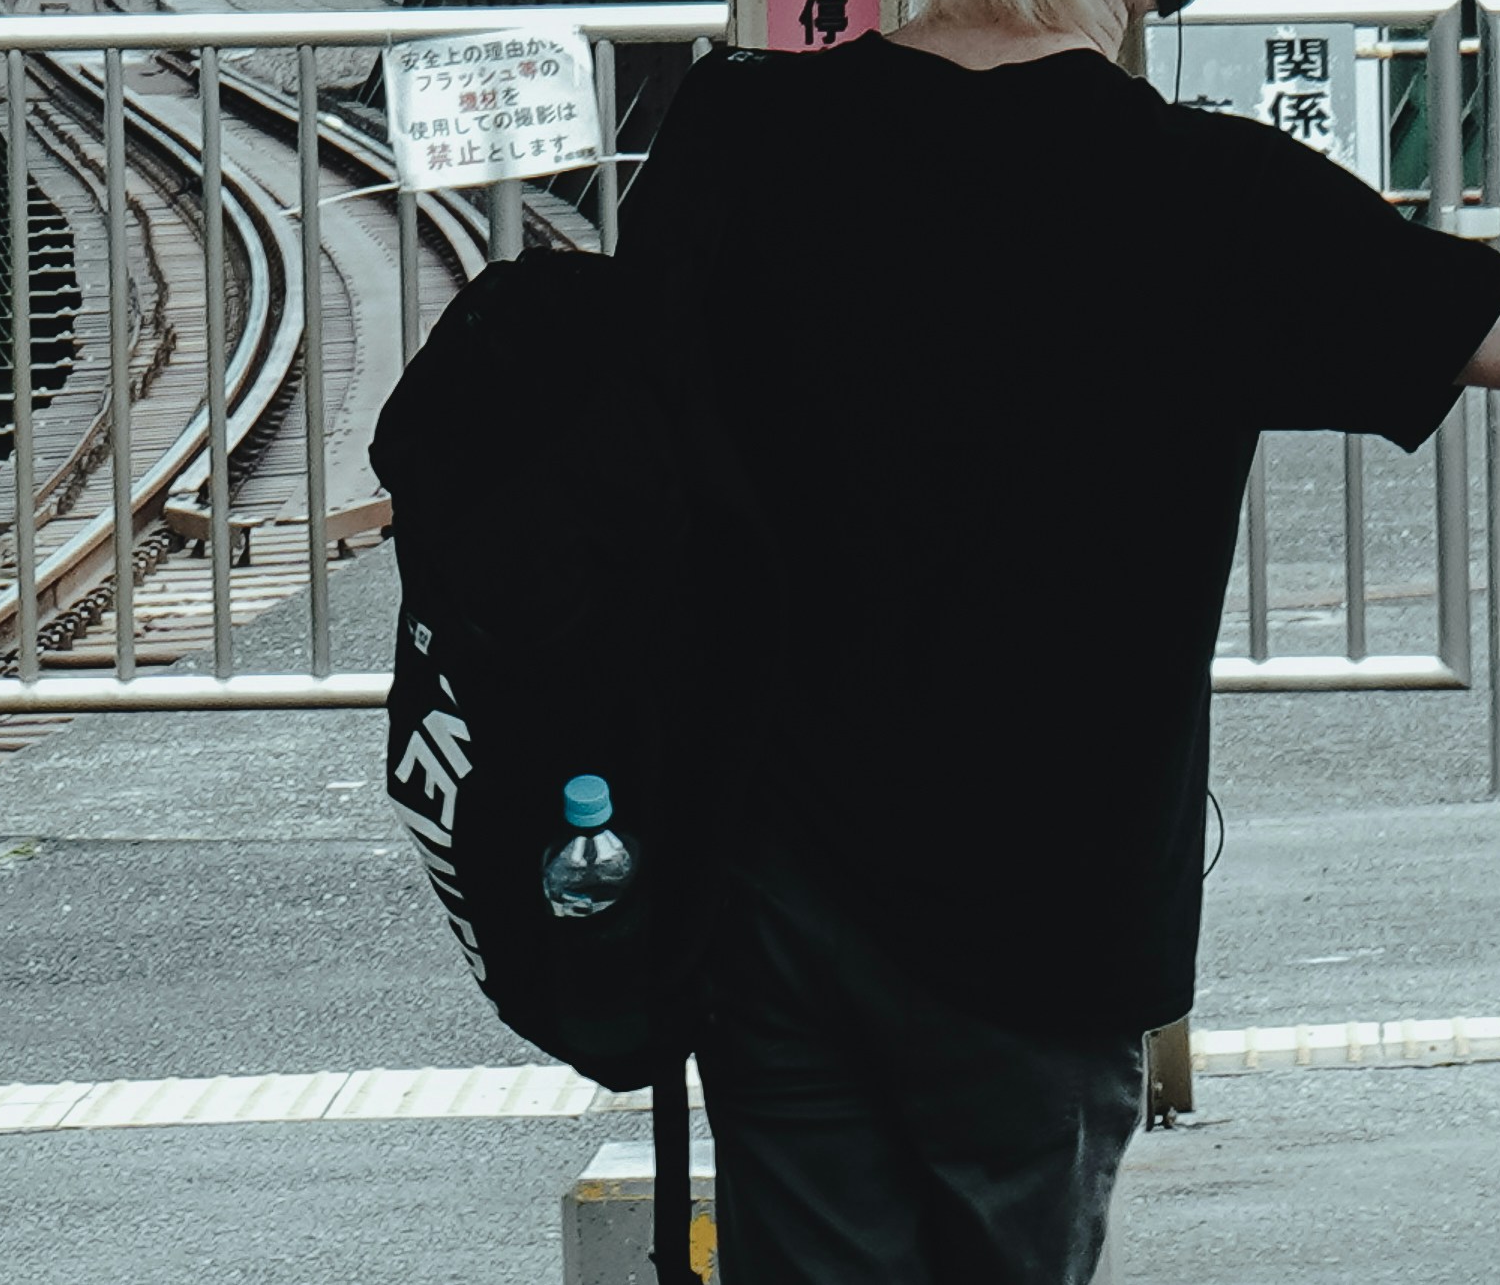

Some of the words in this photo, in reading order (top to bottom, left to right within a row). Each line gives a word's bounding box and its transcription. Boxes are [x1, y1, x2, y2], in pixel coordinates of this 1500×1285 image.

[426, 134, 569, 171] 禁止とします
